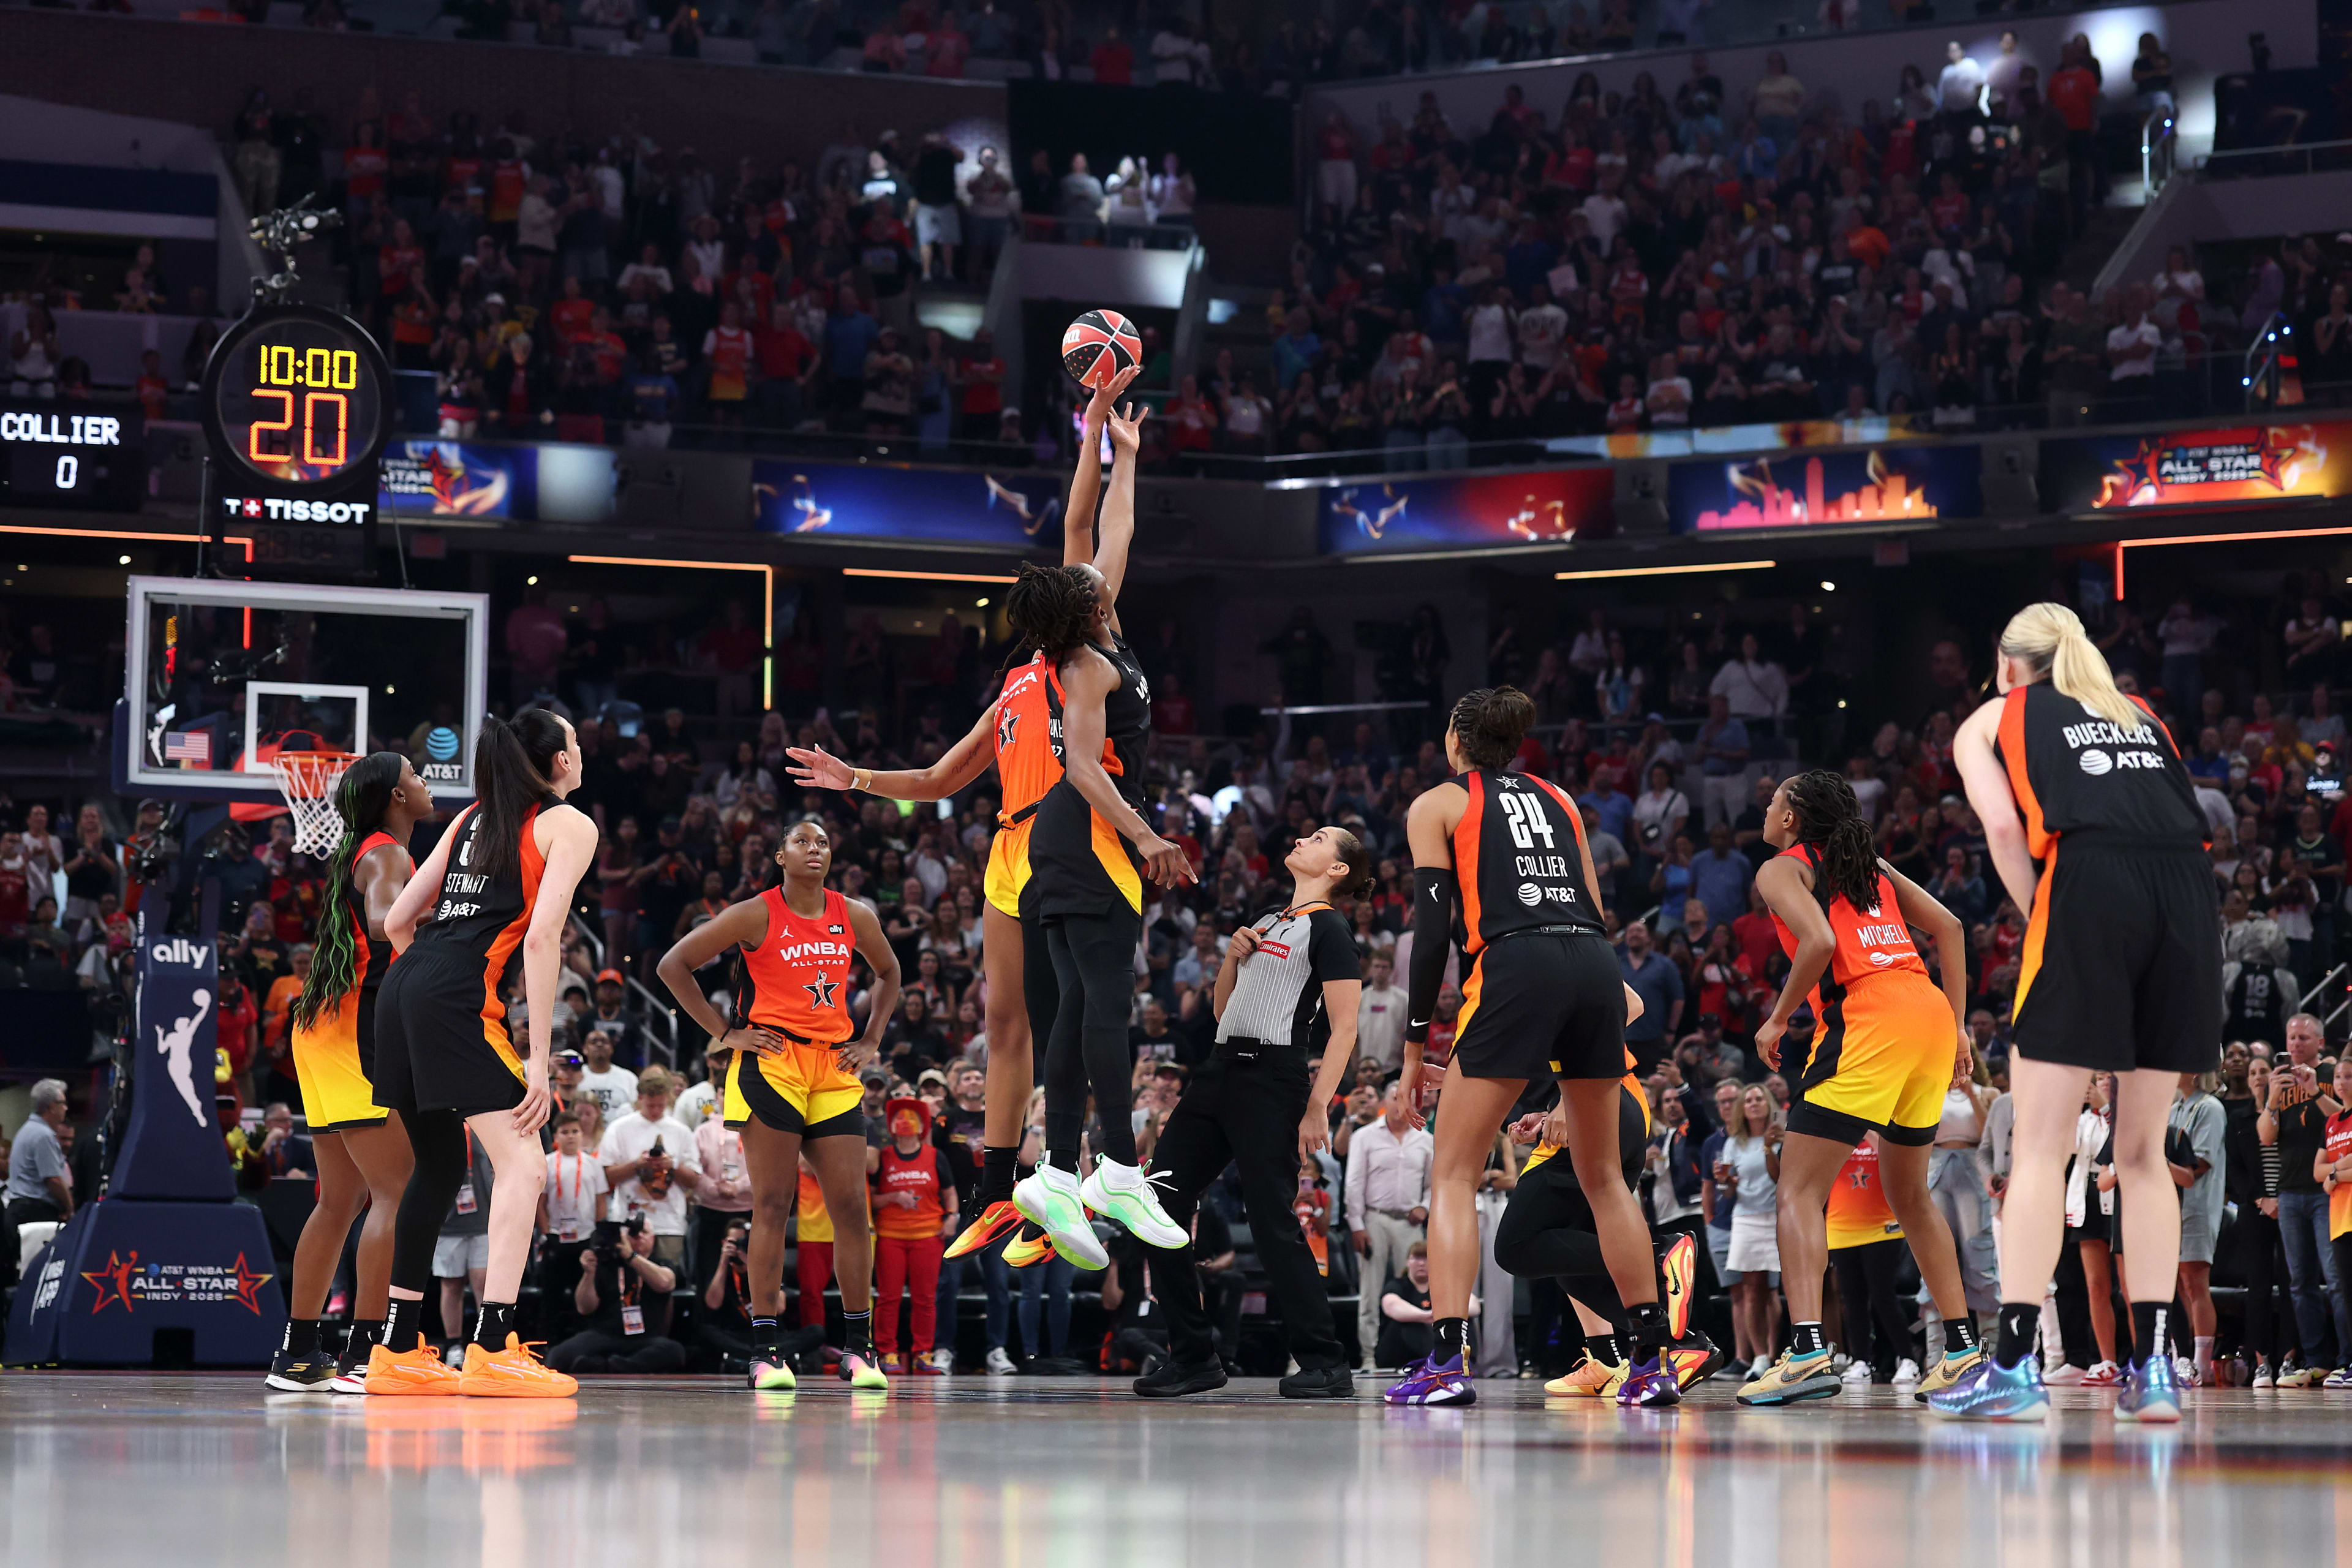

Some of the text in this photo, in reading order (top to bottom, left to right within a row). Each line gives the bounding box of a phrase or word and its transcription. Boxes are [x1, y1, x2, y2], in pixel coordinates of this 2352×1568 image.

[260, 345, 357, 390] 10:00
[1, 412, 120, 445] COLLIER
[249, 388, 348, 466] 20
[56, 455, 78, 489] 0
[2160, 454, 2261, 475] ALL STAR
[264, 498, 370, 524] TISSOT
[2062, 722, 2158, 749] BUECKERS
[421, 763, 462, 780] AT&T
[1498, 793, 1555, 848] 24
[1515, 856, 1568, 877] COLLIER
[445, 872, 489, 894] STEWART
[1544, 886, 1576, 903] AT&T
[829, 925, 842, 933] ally
[1856, 924, 1910, 948] MITCHELL
[152, 938, 209, 970] ally
[780, 942, 850, 961] WNBA
[1259, 943, 1288, 956] Emirates
[187, 1266, 224, 1275] WNBA
[131, 1277, 238, 1290] ALL STAR
[146, 1292, 181, 1301] INDY
